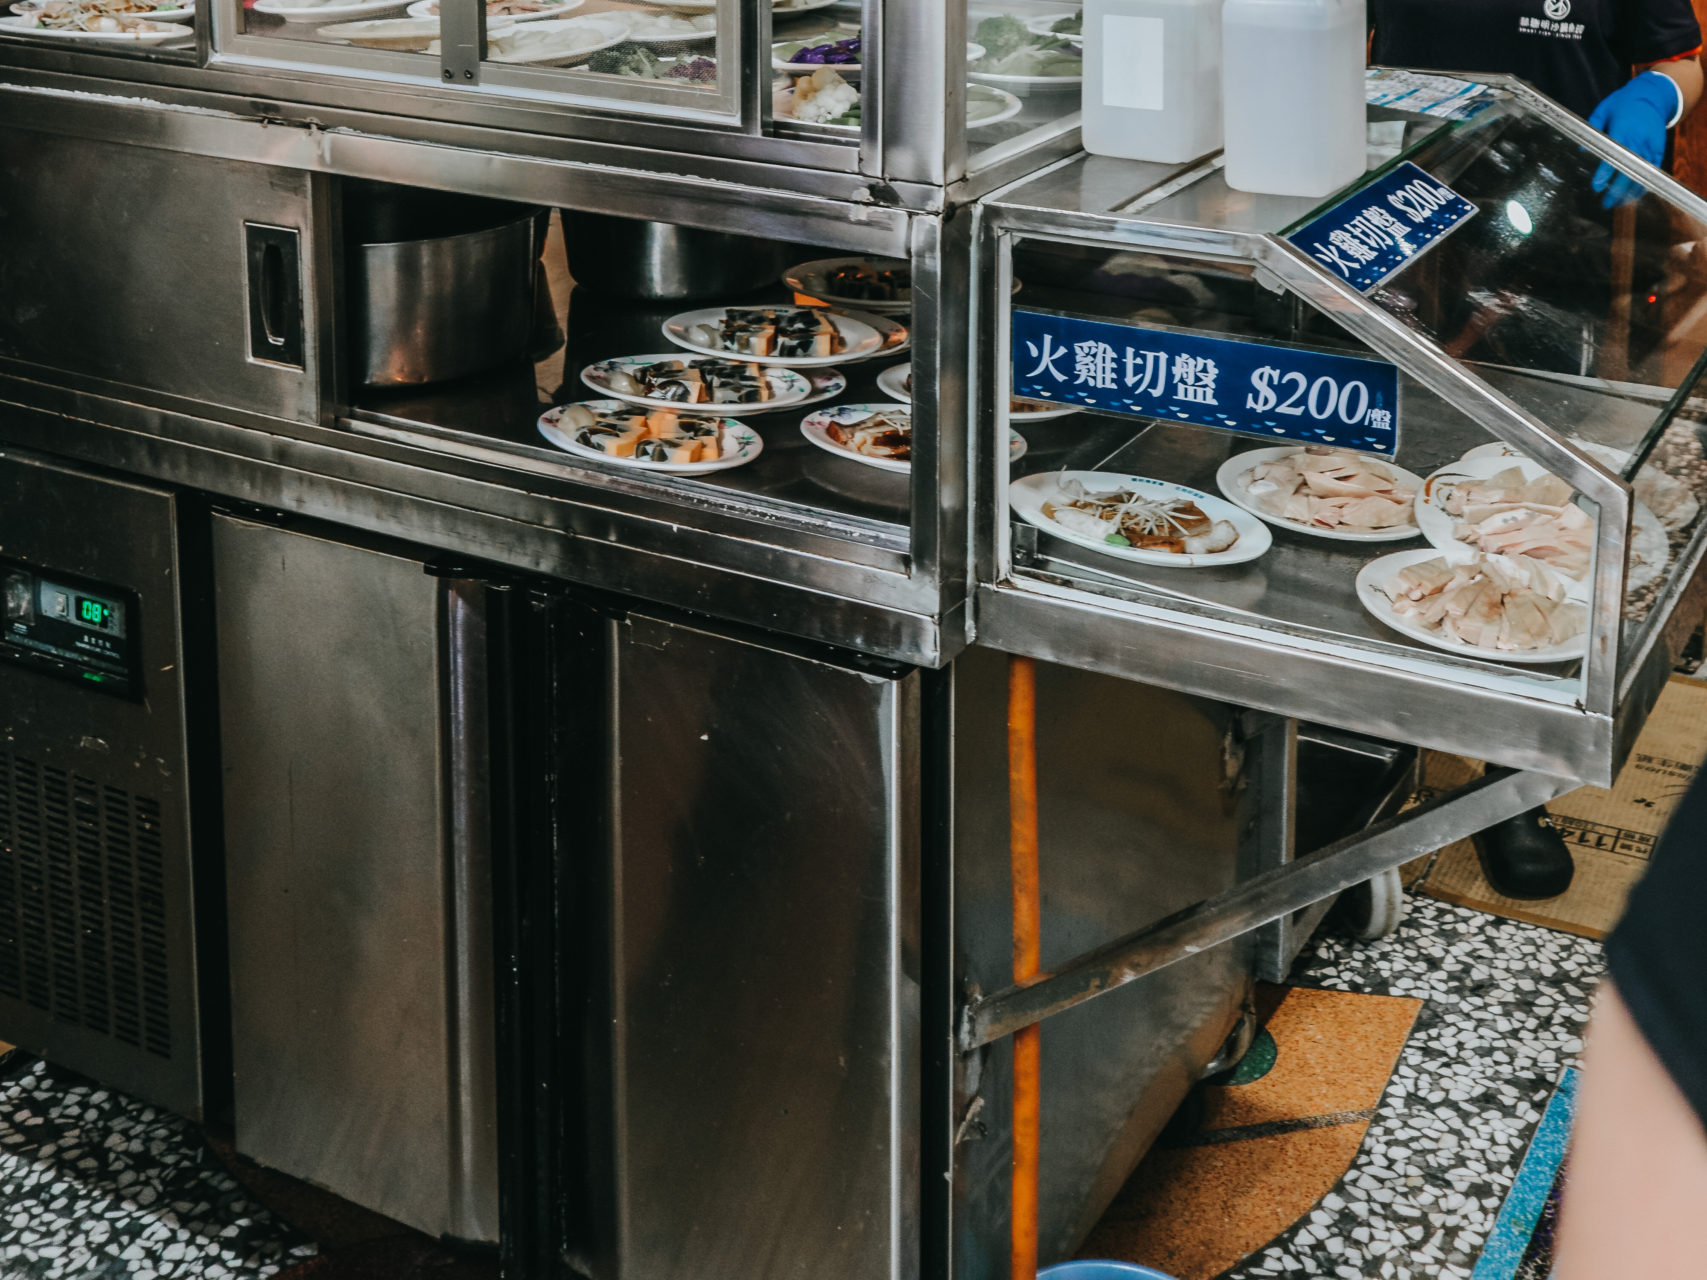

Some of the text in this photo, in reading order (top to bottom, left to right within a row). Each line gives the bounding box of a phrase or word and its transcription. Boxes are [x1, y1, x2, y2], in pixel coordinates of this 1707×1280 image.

[1313, 204, 1413, 278] 火雞切盤
[1025, 332, 1220, 407] 火雞切盤
[82, 600, 103, 624] 08
